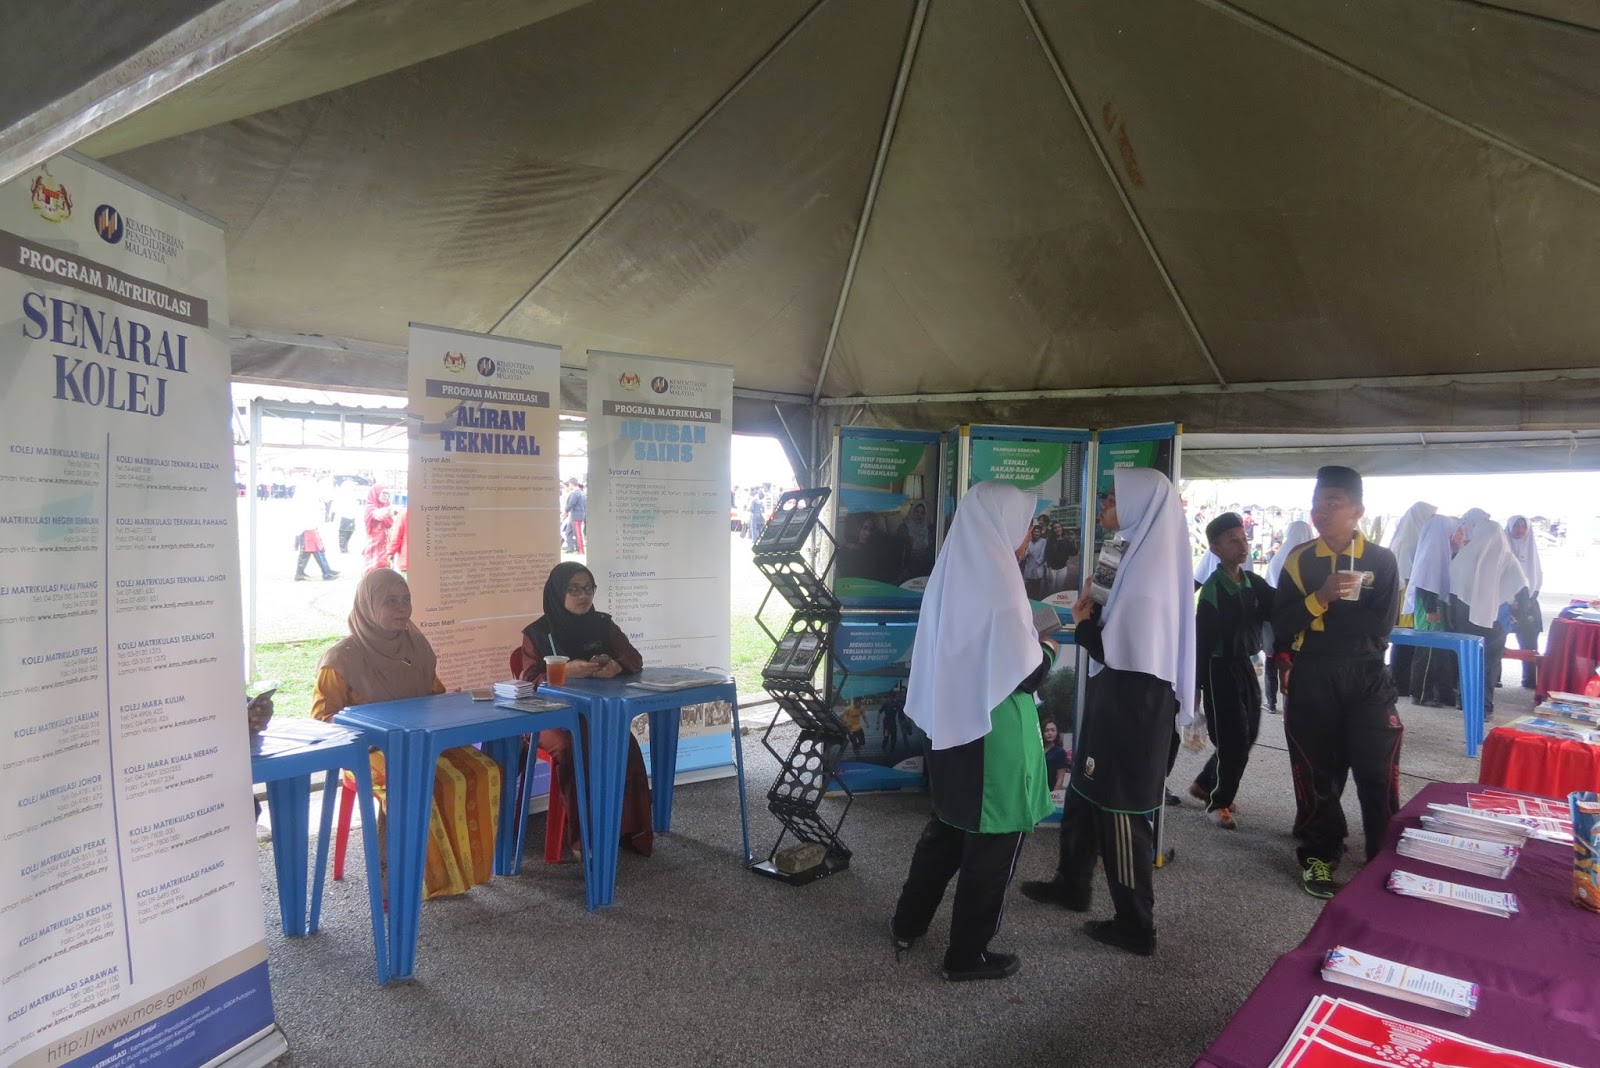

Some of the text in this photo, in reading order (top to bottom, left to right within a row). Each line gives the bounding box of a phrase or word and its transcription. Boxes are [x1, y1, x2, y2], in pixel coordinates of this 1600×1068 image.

[125, 217, 184, 250] KEMENTERIAN
[125, 228, 177, 258] PENDIDIKAN
[125, 240, 166, 264] MALAYSIA
[19, 246, 192, 317] PROGRAM MATRIKULASI
[22, 291, 189, 374] SENARAI
[52, 354, 168, 418] KOLEJ
[496, 373, 523, 381] MALAYSIA
[441, 385, 538, 403] PROGRAM MATRIKULASI
[456, 406, 526, 431] ALIRAN
[614, 404, 712, 420] PROGRAM MATRIKULASI
[619, 420, 706, 443] JURUSAN
[9, 444, 80, 459] KOLEJ MATRIKULASI
[440, 430, 541, 456] TEKNIKAL
[634, 442, 693, 463] SAINS
[116, 455, 220, 470] KOLEJ MATRIKULASI TEKNIKAL KEDAH
[420, 456, 440, 464] Syarat
[990, 465, 1040, 474] RAKAN-RAKAN
[608, 468, 629, 476] Syarat
[0, 515, 51, 525] MATRIKULASI
[116, 518, 228, 526] KOLEJ MATRIKULASI TEKNIKAL PAHANG
[11, 584, 59, 595] MATRIKULASI
[77, 581, 98, 590] PINANG
[116, 574, 227, 588] KOLEJ MATRIKULASI TEKNIKAL JOHOR
[420, 620, 441, 628] Kiraan
[117, 632, 215, 651] KOLEJ MATRIKULASI SELANGOR
[21, 646, 98, 666] KOLEJ MATRIKULASI PERLIS
[119, 694, 186, 713] KOLEJ MARA KULIM
[13, 710, 100, 739] KOLEJ MATRIKULASI LABUAN
[120, 729, 142, 739] Laman
[123, 746, 219, 775] KOLEJ MARA KUALA NERANG
[17, 774, 102, 808] KOLEJ MATRIKULASI JOHOR
[125, 790, 148, 801] Laman
[129, 801, 225, 837] KOLEJ MATRIKULASI KELANTAN
[20, 838, 107, 877] KOLEJ MATRIKULASI PERAK
[131, 851, 154, 862] Laman
[136, 859, 225, 899] KOLEJ MATRIKULASI PAHANG
[18, 902, 112, 948] KOLEJ MATRIKULASI KEDAH
[7, 965, 119, 1022] KOLEJ MATRIKULASI SARAWAK
[47, 975, 208, 1063] http://www.moe.gov.my
